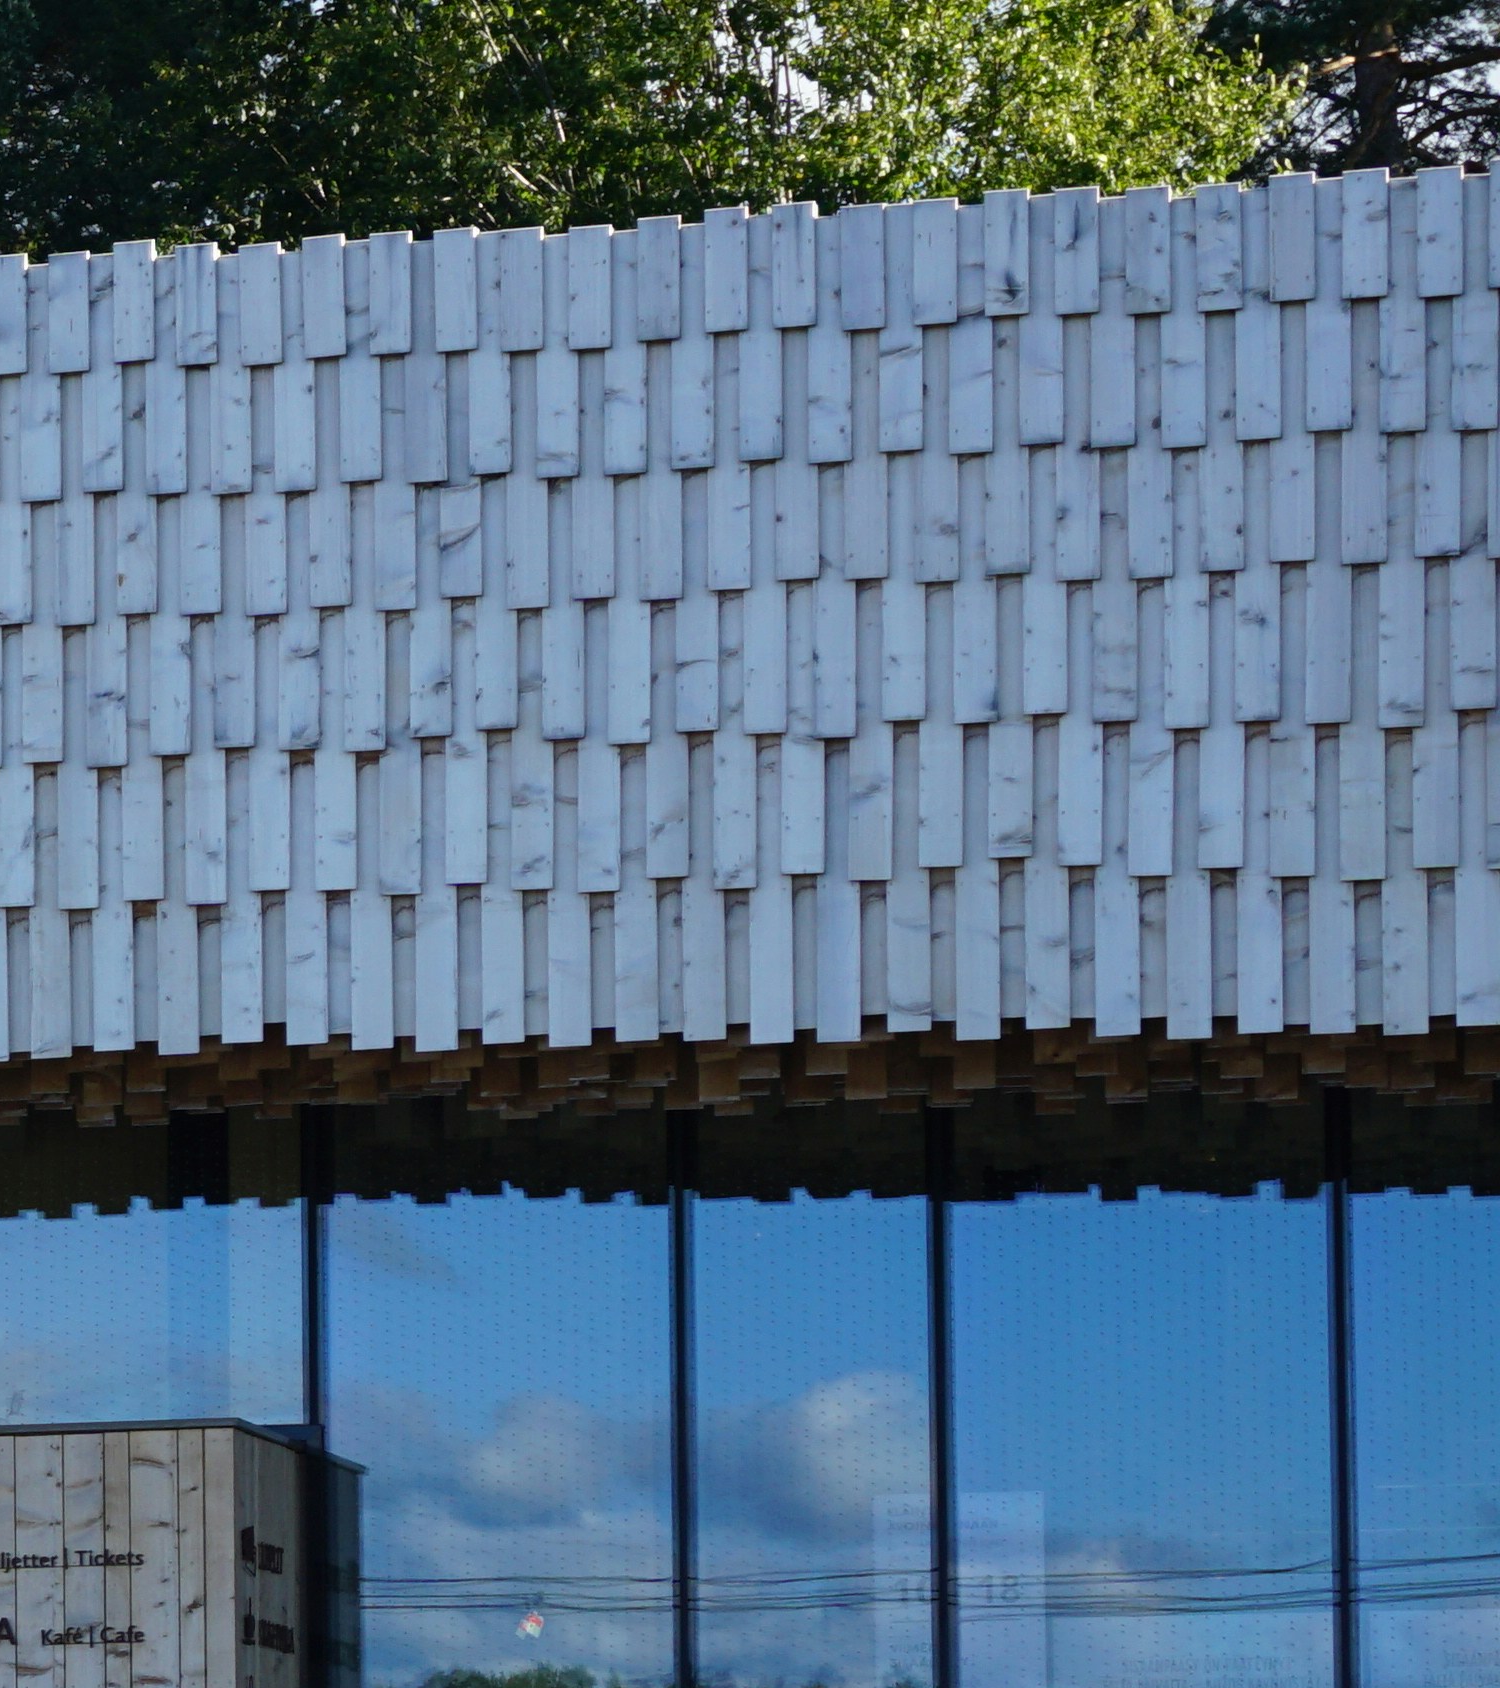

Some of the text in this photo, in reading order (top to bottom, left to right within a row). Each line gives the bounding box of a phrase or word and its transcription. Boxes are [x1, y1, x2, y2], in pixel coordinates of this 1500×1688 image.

[75, 1549, 145, 1567] Tickets
[41, 1626, 84, 1646] Kafé
[100, 1626, 145, 1645] Cafe
